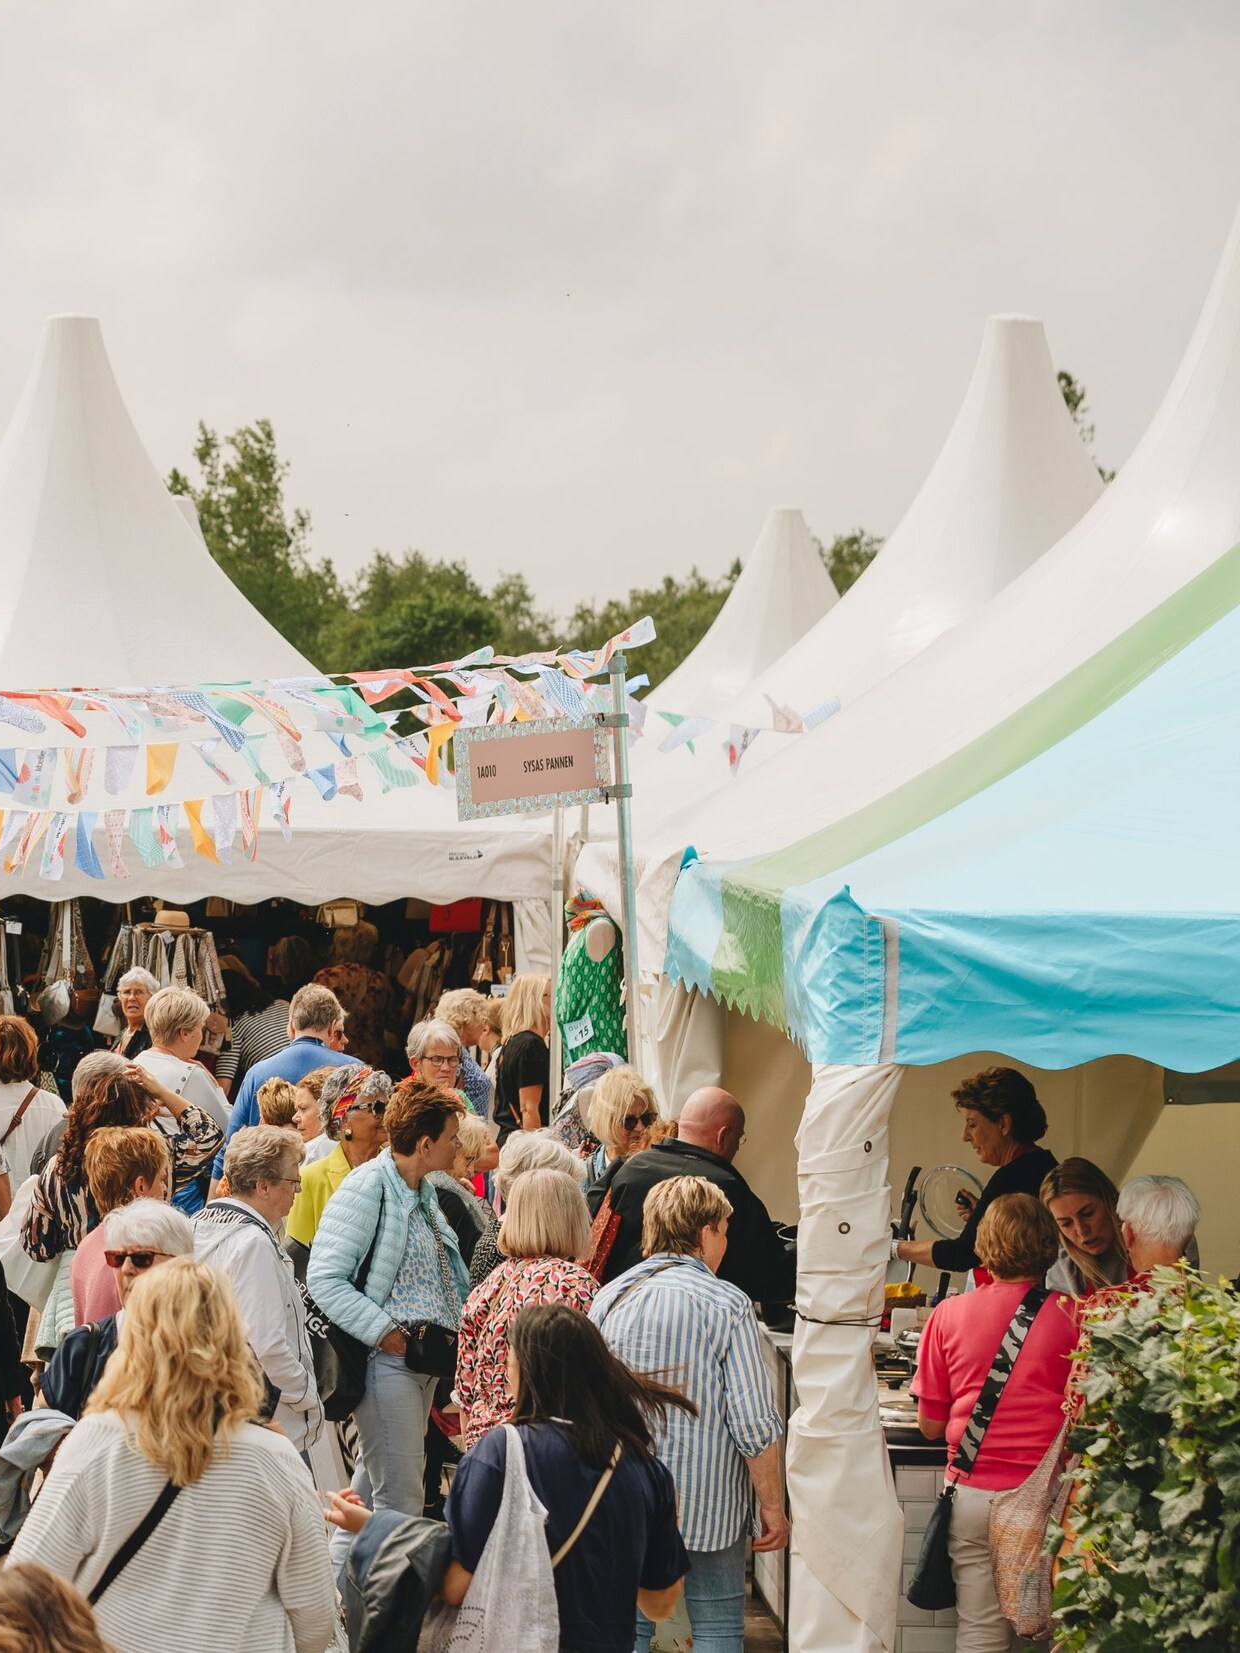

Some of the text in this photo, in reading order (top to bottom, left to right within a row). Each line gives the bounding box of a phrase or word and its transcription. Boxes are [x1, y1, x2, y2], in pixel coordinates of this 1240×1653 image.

[477, 755, 574, 779] 1A010 SYSAS PANNEN
